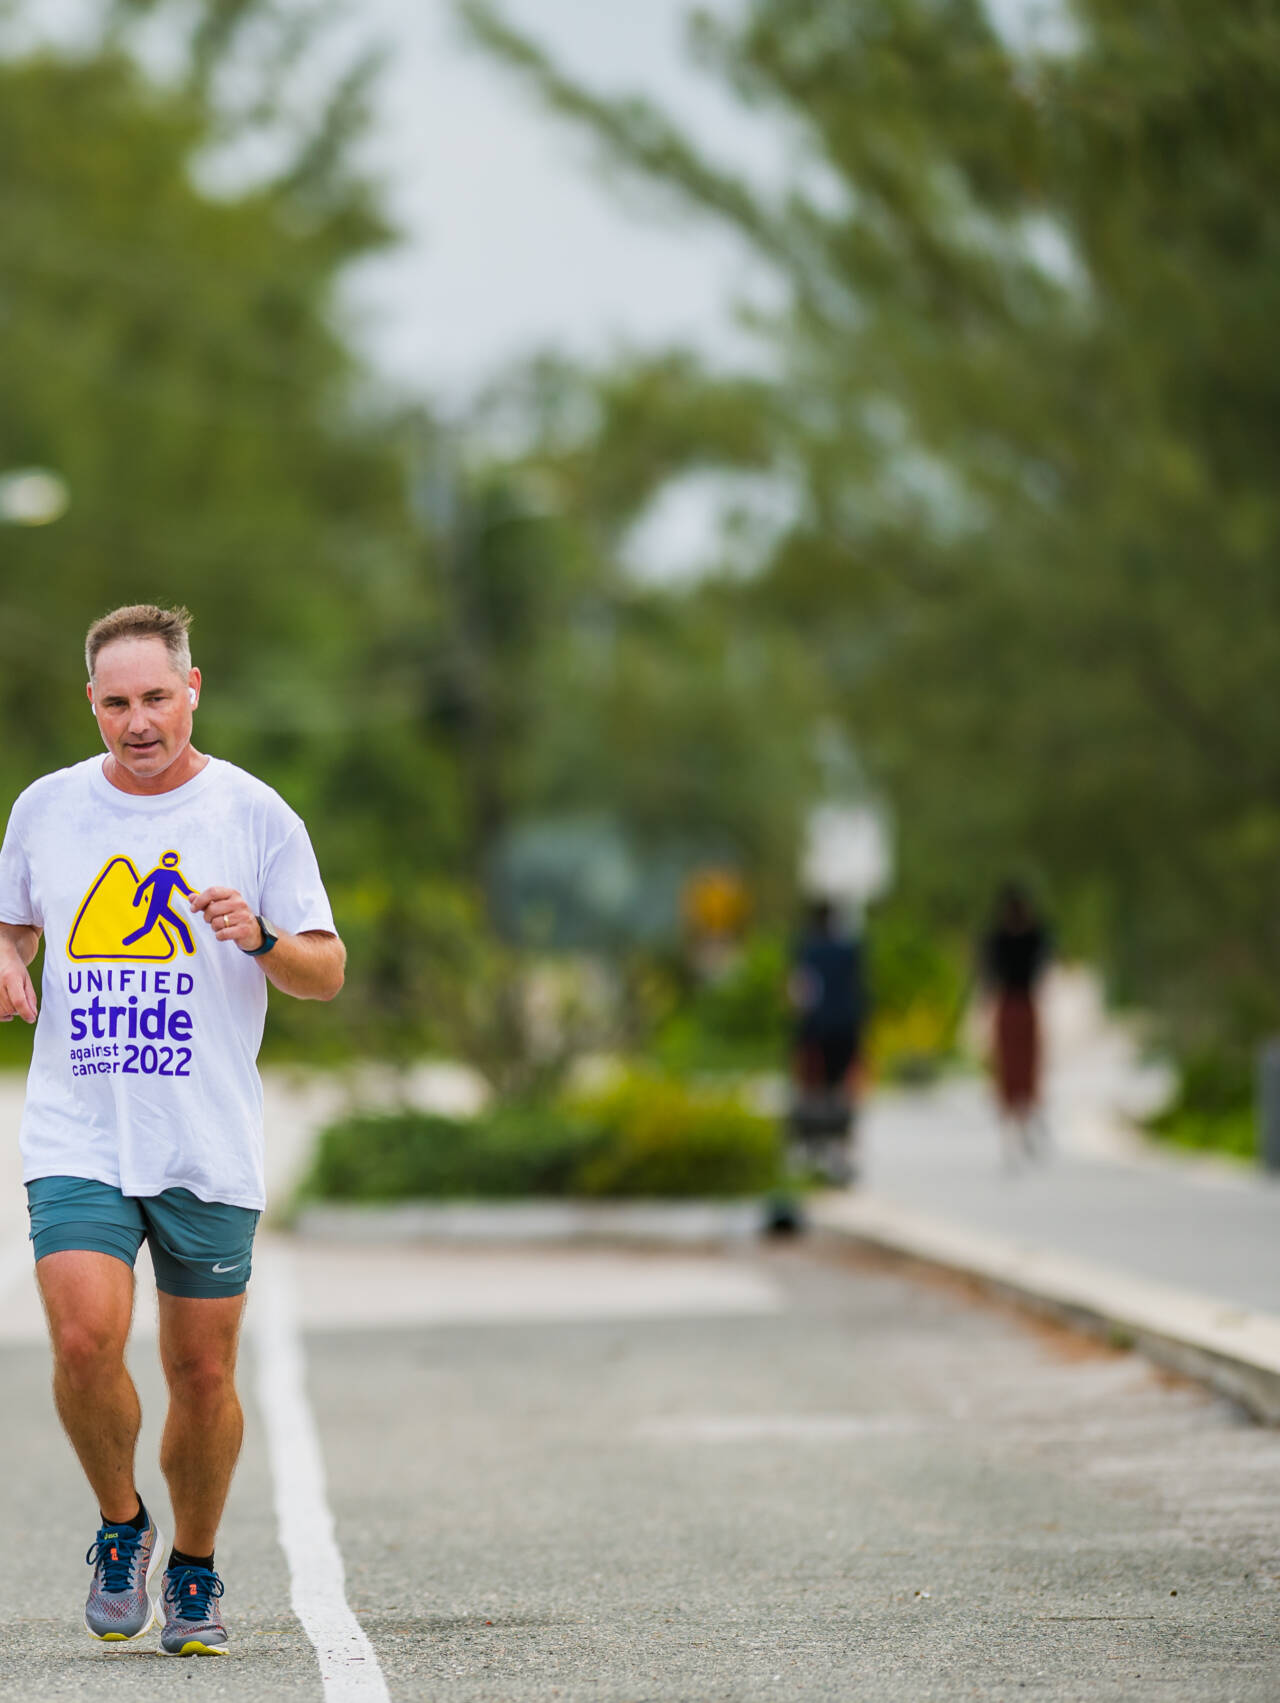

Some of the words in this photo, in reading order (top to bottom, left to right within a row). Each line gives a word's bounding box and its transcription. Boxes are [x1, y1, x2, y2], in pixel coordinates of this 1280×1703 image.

[68, 969, 194, 995] UNIFIED
[70, 995, 193, 1041] stride
[70, 1043, 119, 1062] against
[122, 1044, 192, 1076] 2022
[72, 1062, 120, 1077] cancer
